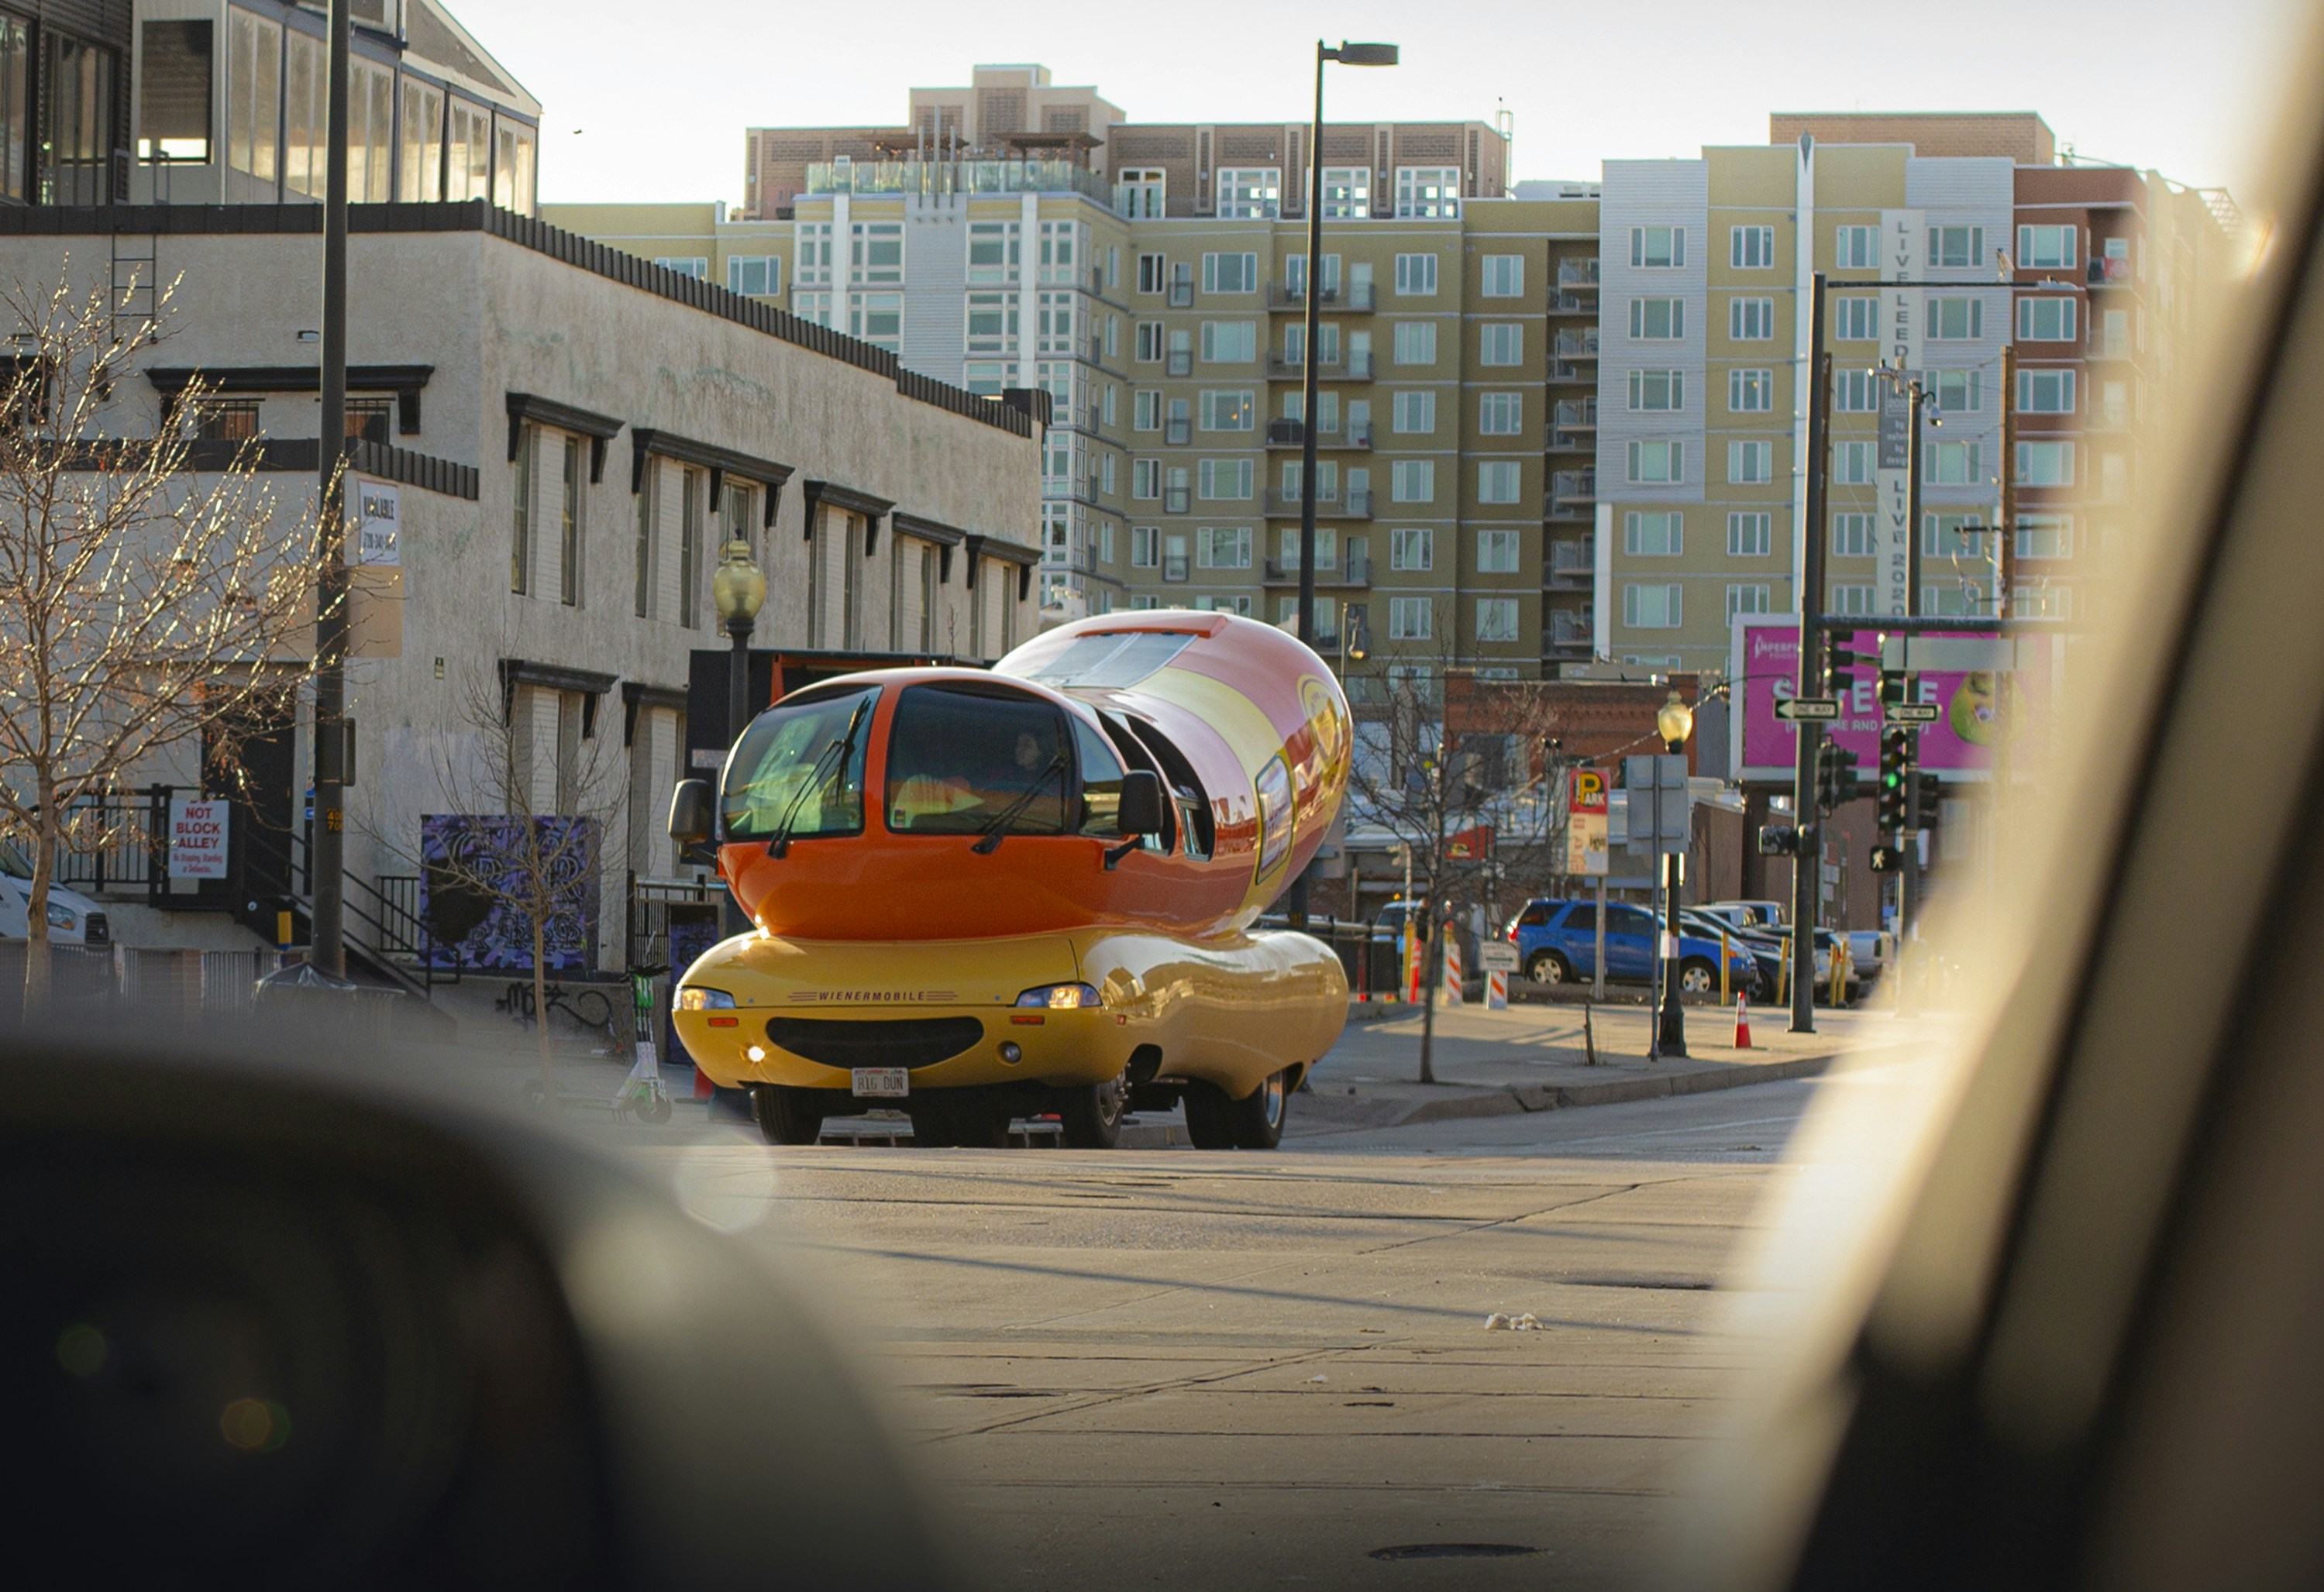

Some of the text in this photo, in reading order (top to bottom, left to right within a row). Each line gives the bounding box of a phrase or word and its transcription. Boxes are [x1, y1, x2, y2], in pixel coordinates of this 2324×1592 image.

[1814, 704, 1832, 713] WAY
[1852, 719, 1878, 732] AND
[186, 807, 212, 819] NOT
[177, 822, 221, 834] BLOCK
[178, 837, 219, 848] ALLEY
[818, 991, 924, 1001] WIENERMOBILE
